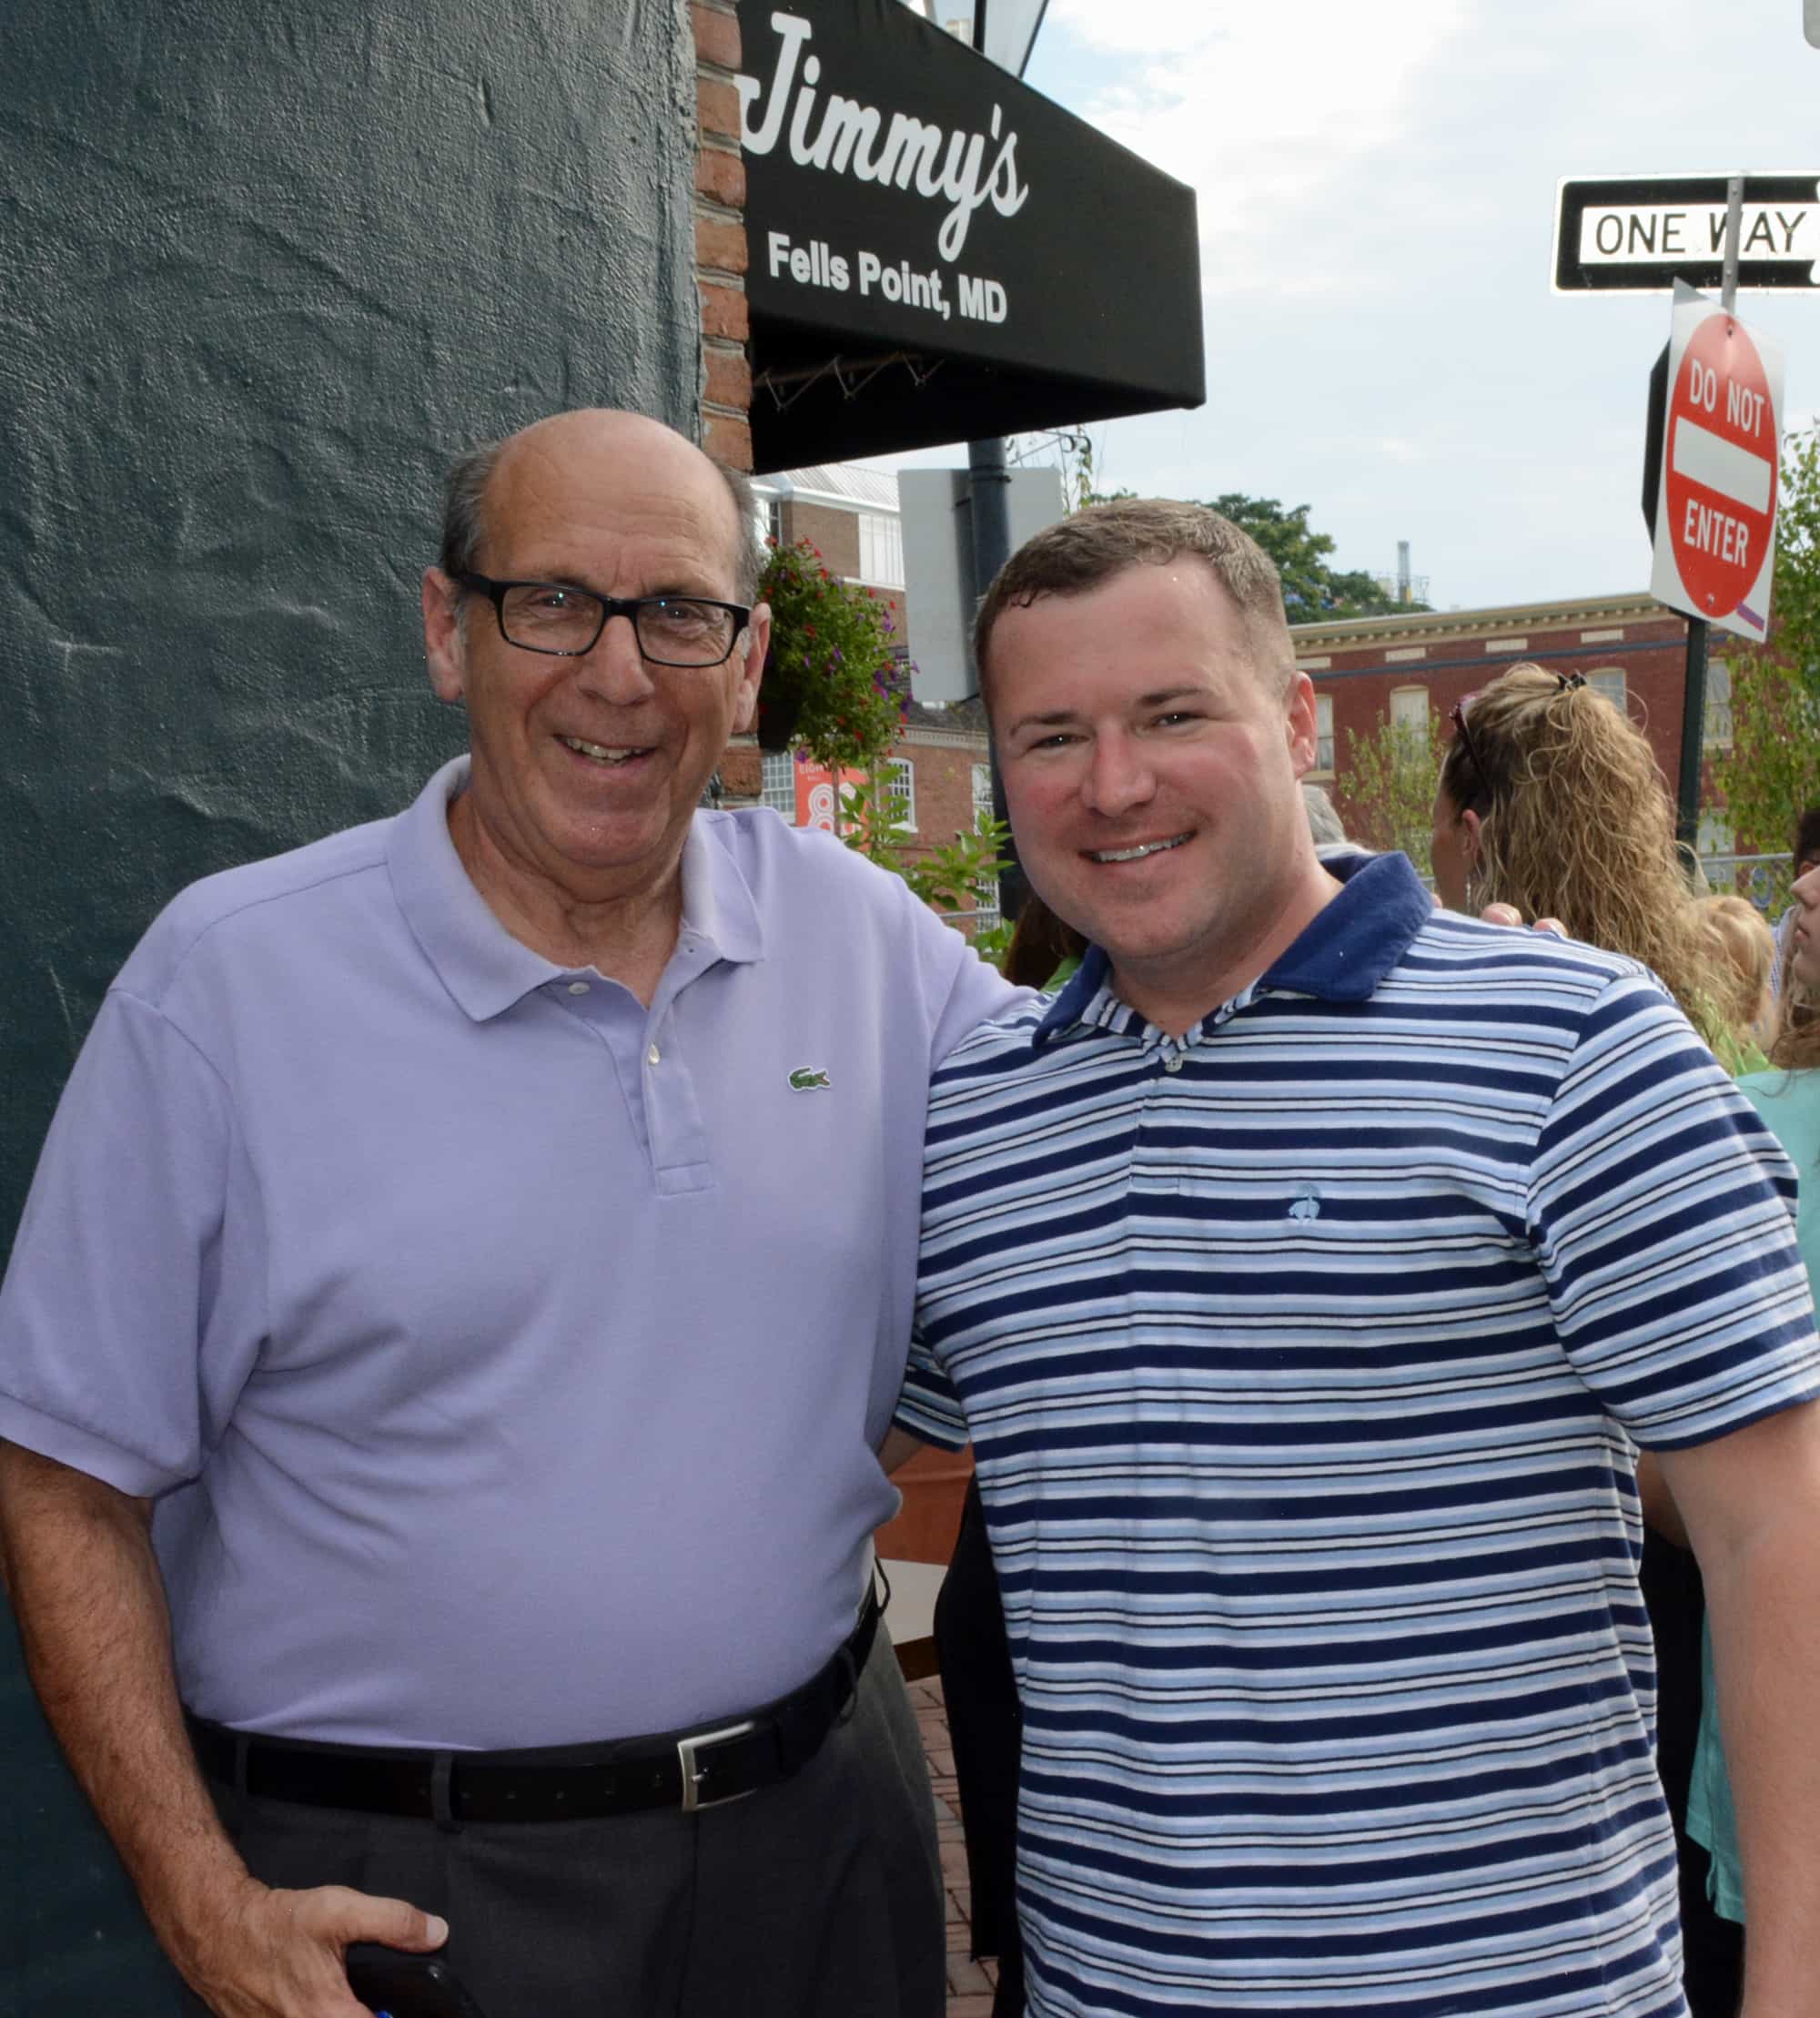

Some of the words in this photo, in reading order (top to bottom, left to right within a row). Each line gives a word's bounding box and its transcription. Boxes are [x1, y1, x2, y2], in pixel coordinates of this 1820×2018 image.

[735, 12, 1028, 262] Jimmy's
[1595, 213, 1686, 255] ONE
[768, 231, 851, 292] Fells
[858, 251, 951, 320] Point,
[957, 276, 1008, 324] MD
[1689, 360, 1717, 412] DO
[1726, 380, 1764, 438] NOT
[1684, 498, 1749, 568] ENTER
